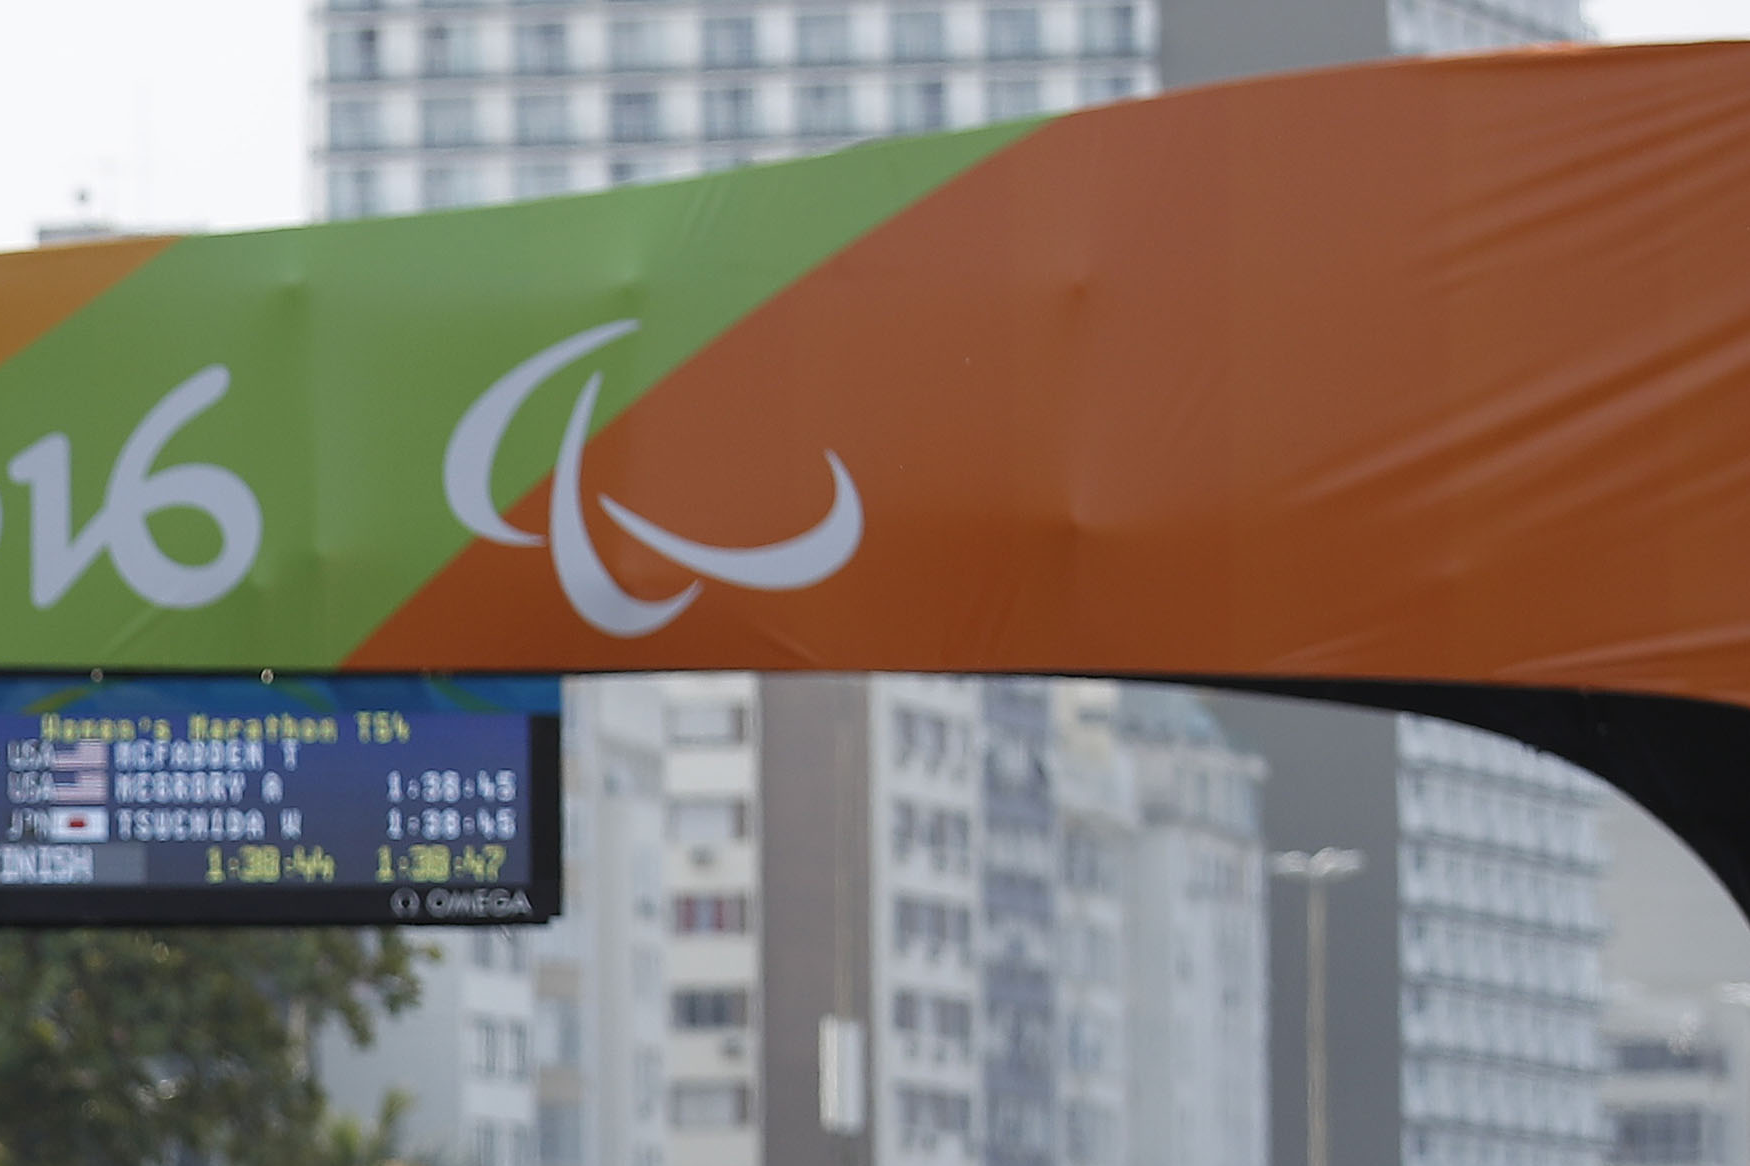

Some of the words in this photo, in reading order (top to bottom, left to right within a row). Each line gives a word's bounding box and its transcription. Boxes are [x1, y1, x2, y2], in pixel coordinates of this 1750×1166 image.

[189, 712, 338, 744] Marathon
[356, 711, 410, 744] T54
[426, 888, 533, 918] OMEGA
